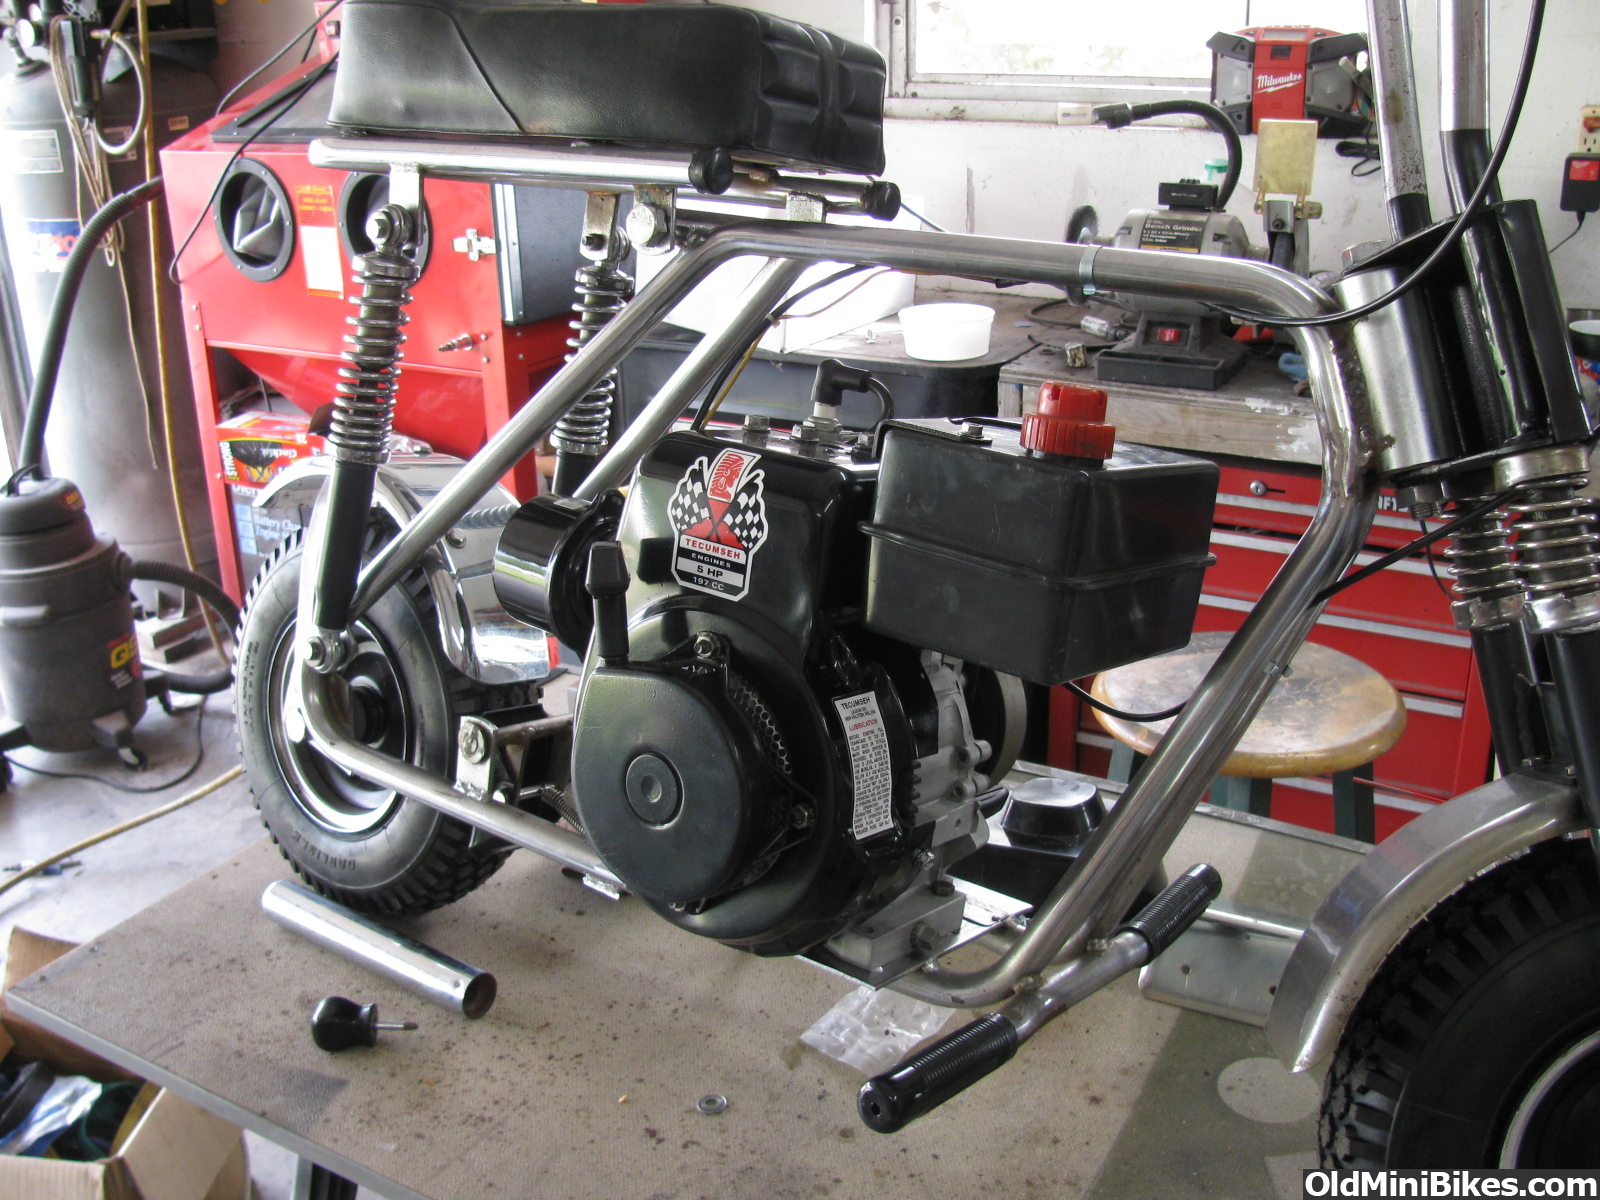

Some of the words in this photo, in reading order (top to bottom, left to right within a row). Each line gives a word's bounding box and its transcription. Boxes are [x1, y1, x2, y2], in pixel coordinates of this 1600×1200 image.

[1256, 72, 1302, 89] Milwaukee
[220, 442, 238, 476] STRONG
[254, 514, 280, 531] Battery
[282, 518, 302, 531] Cha
[256, 526, 280, 540] Engine
[685, 538, 741, 560] TECUMSEH
[692, 552, 732, 568] ENGINES
[696, 566, 704, 574] 5
[707, 566, 724, 579] HP
[693, 576, 709, 586] 197
[712, 581, 724, 591] CC
[841, 697, 870, 709] TECUMSEH
[849, 718, 878, 731] LUBRICATION
[292, 830, 356, 870] CARLISLE
